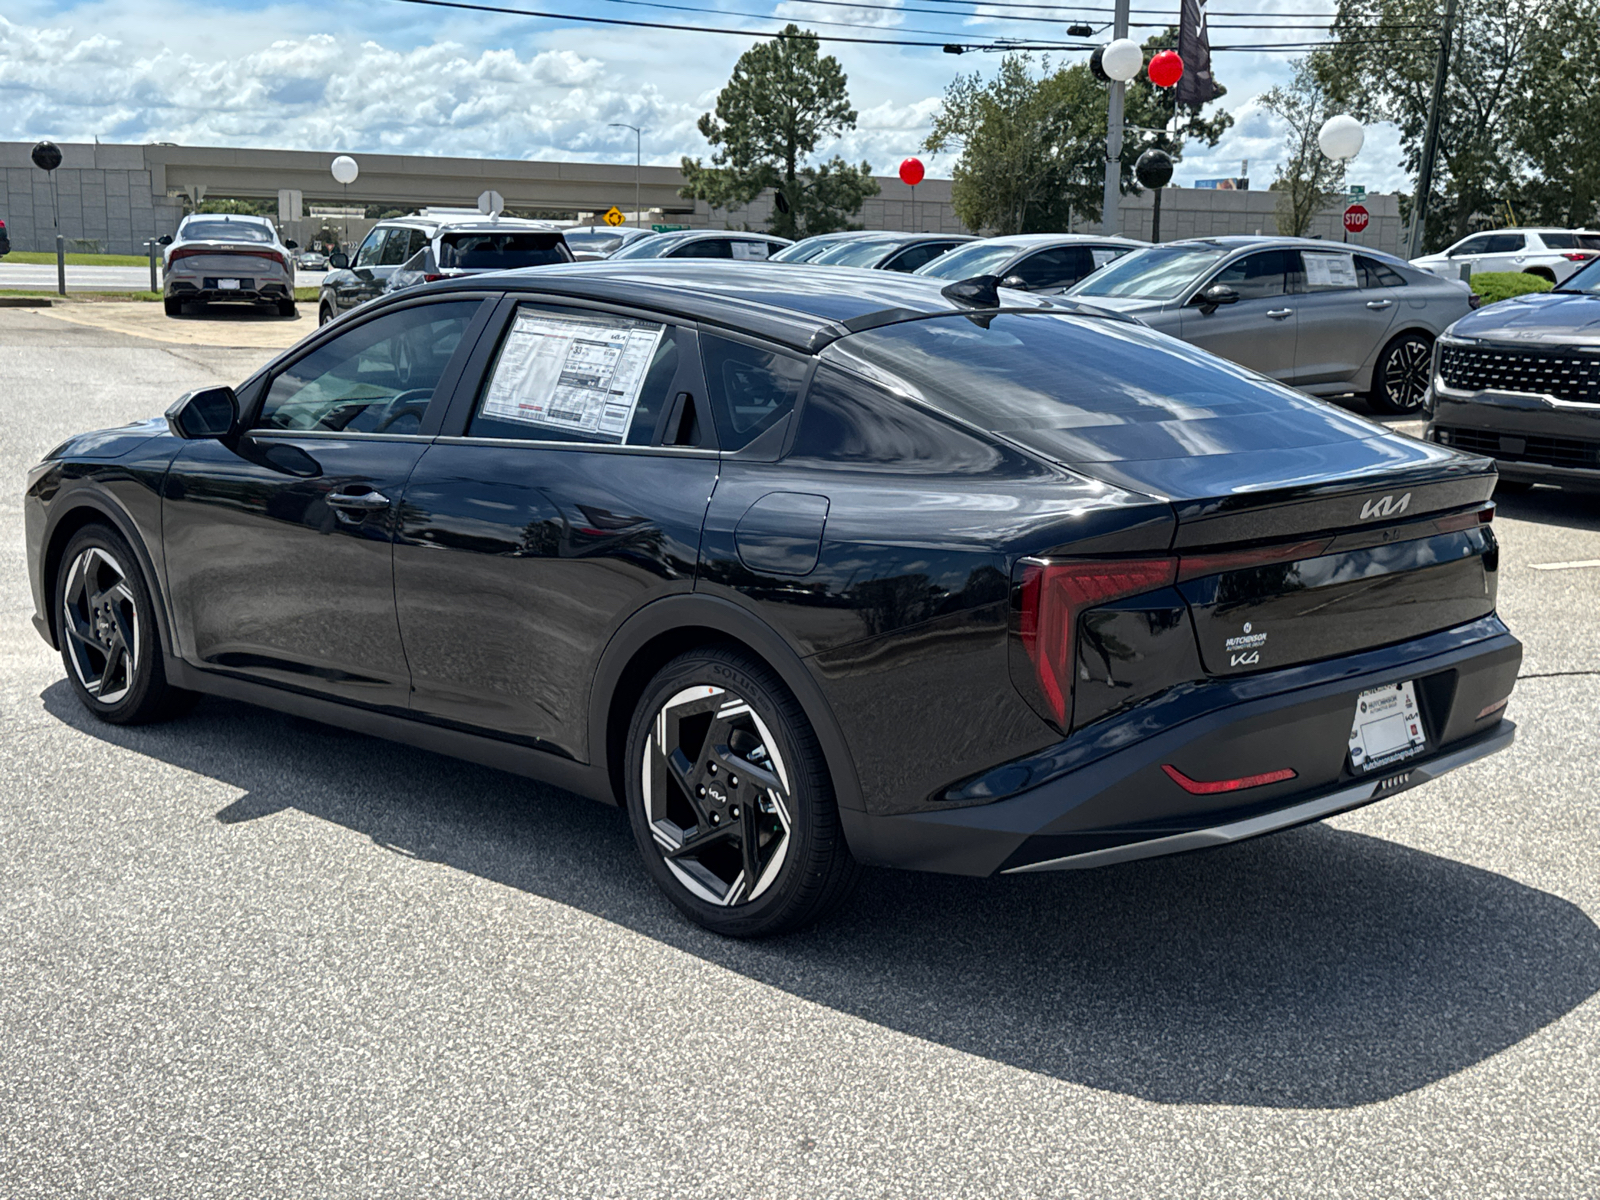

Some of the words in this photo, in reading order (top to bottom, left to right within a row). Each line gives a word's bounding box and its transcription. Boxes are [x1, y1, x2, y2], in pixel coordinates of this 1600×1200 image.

[1345, 213, 1368, 225] STOP
[1360, 492, 1411, 520] KIA
[1225, 632, 1268, 647] HUTCHINSON
[1230, 651, 1260, 667] K4
[713, 664, 760, 699] SOLUS
[1405, 711, 1419, 721] KIA
[708, 787, 727, 803] KIA
